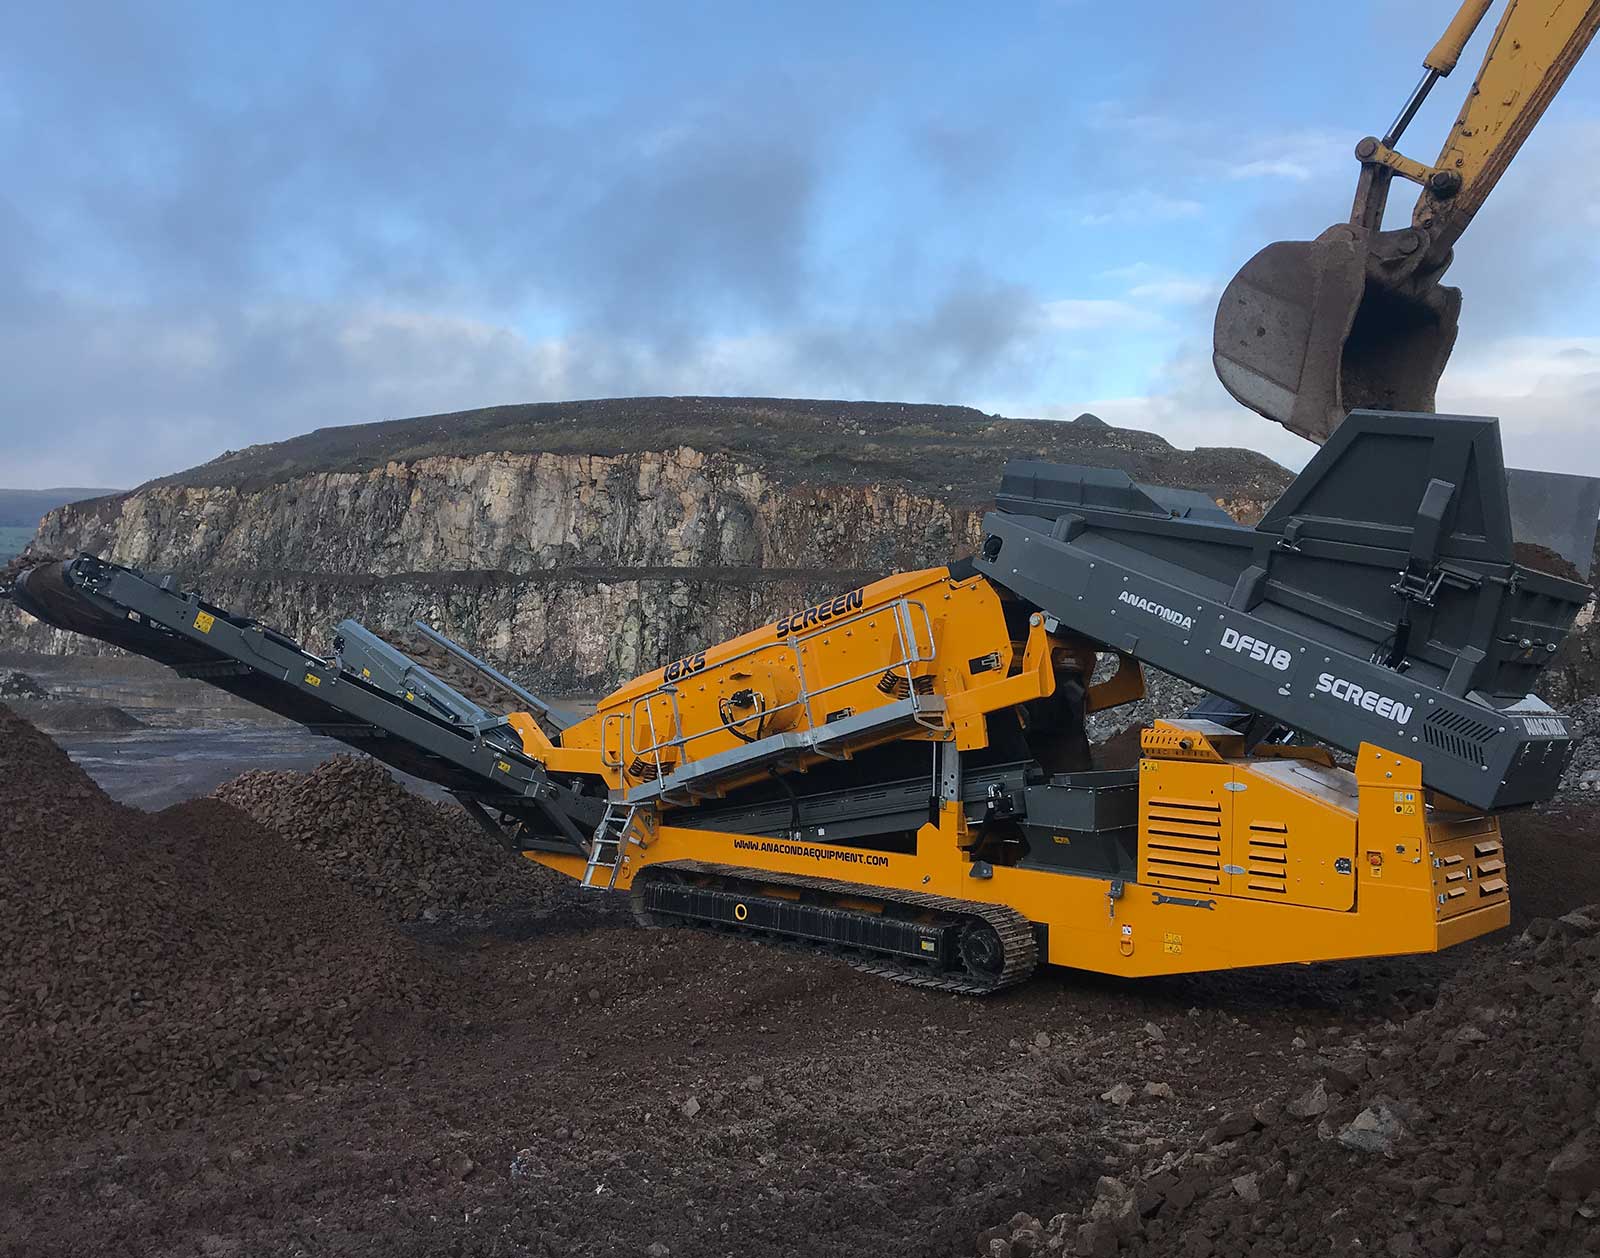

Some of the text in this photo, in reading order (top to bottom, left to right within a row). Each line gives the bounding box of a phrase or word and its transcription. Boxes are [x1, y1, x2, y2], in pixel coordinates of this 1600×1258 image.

[777, 588, 863, 638] SCREEN
[1118, 590, 1414, 725] ANACONDA DF518 SCREEN
[734, 839, 889, 867] WWW.ANACONDAEQUIPMENT.COM
